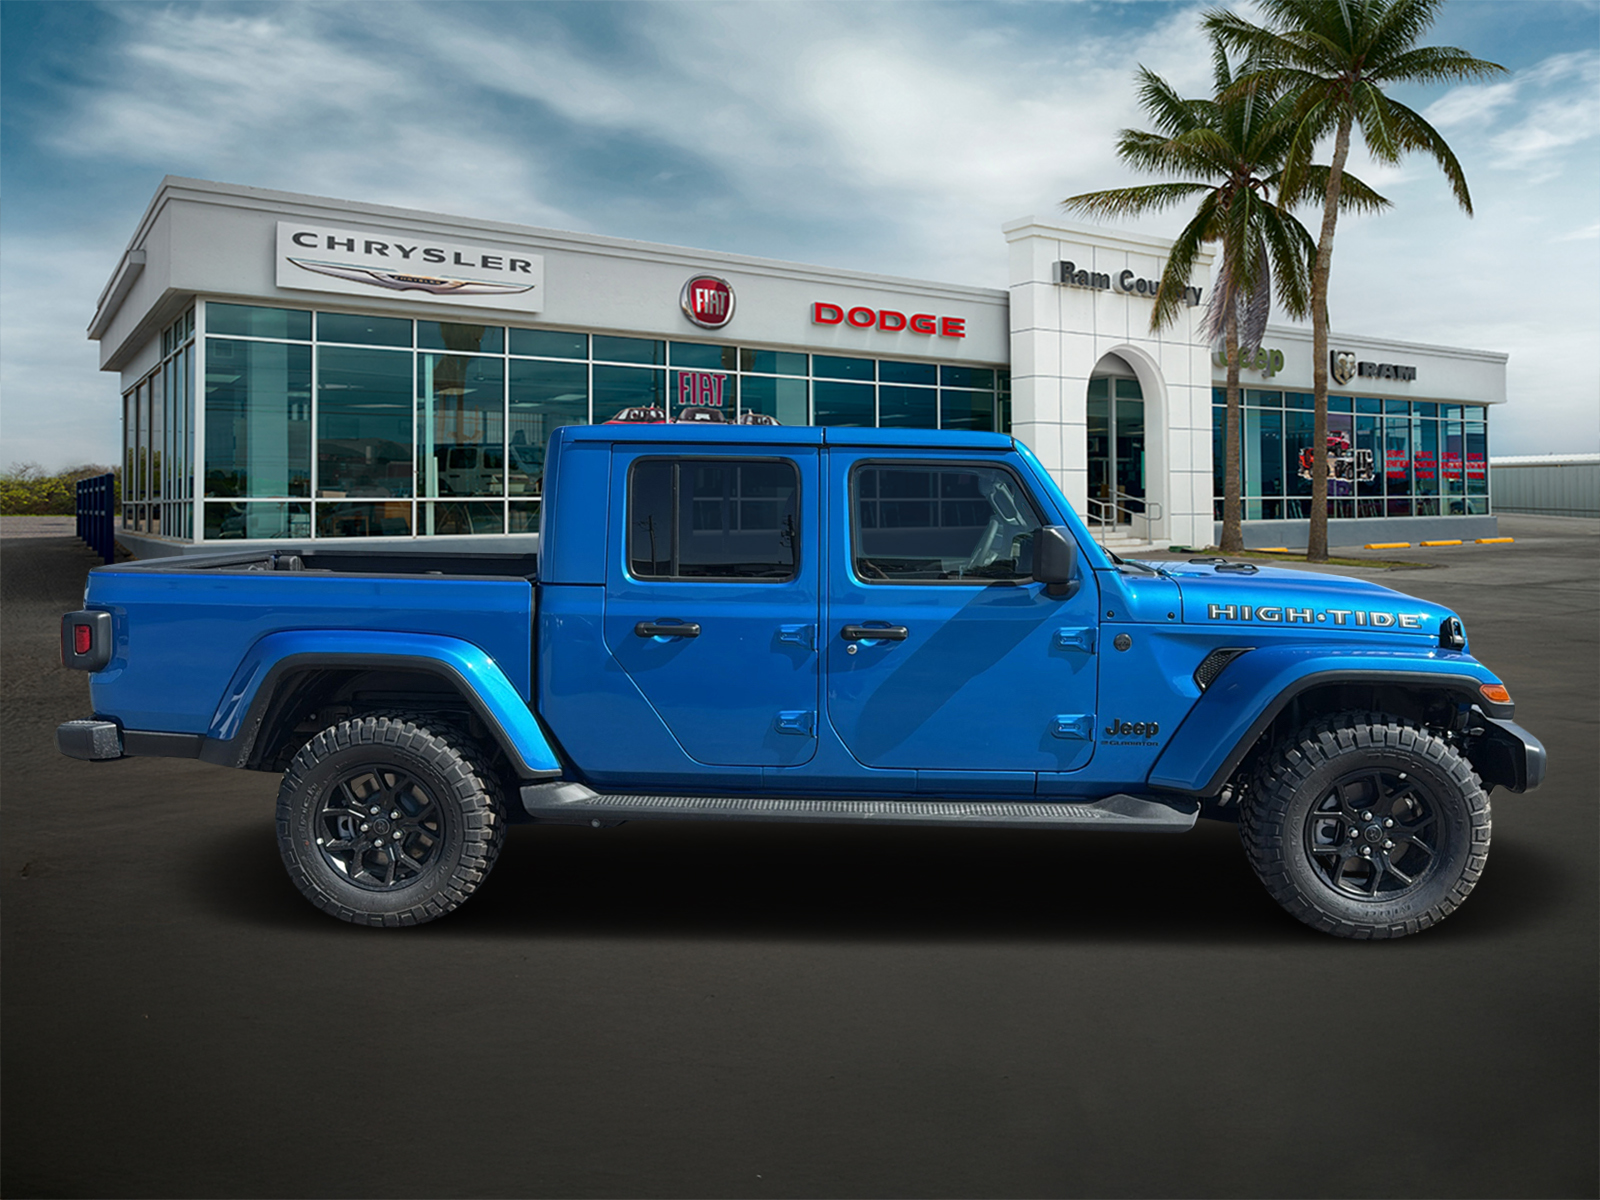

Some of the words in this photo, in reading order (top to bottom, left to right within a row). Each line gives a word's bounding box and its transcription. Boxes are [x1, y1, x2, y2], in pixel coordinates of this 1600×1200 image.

[292, 231, 532, 274] CHRYSLER
[1055, 260, 1110, 290] Ram
[695, 287, 728, 316] FIAT
[811, 301, 966, 339] DODGE
[1358, 361, 1417, 381] RAM
[678, 371, 727, 406] FIAT
[1105, 718, 1160, 739] Jeep
